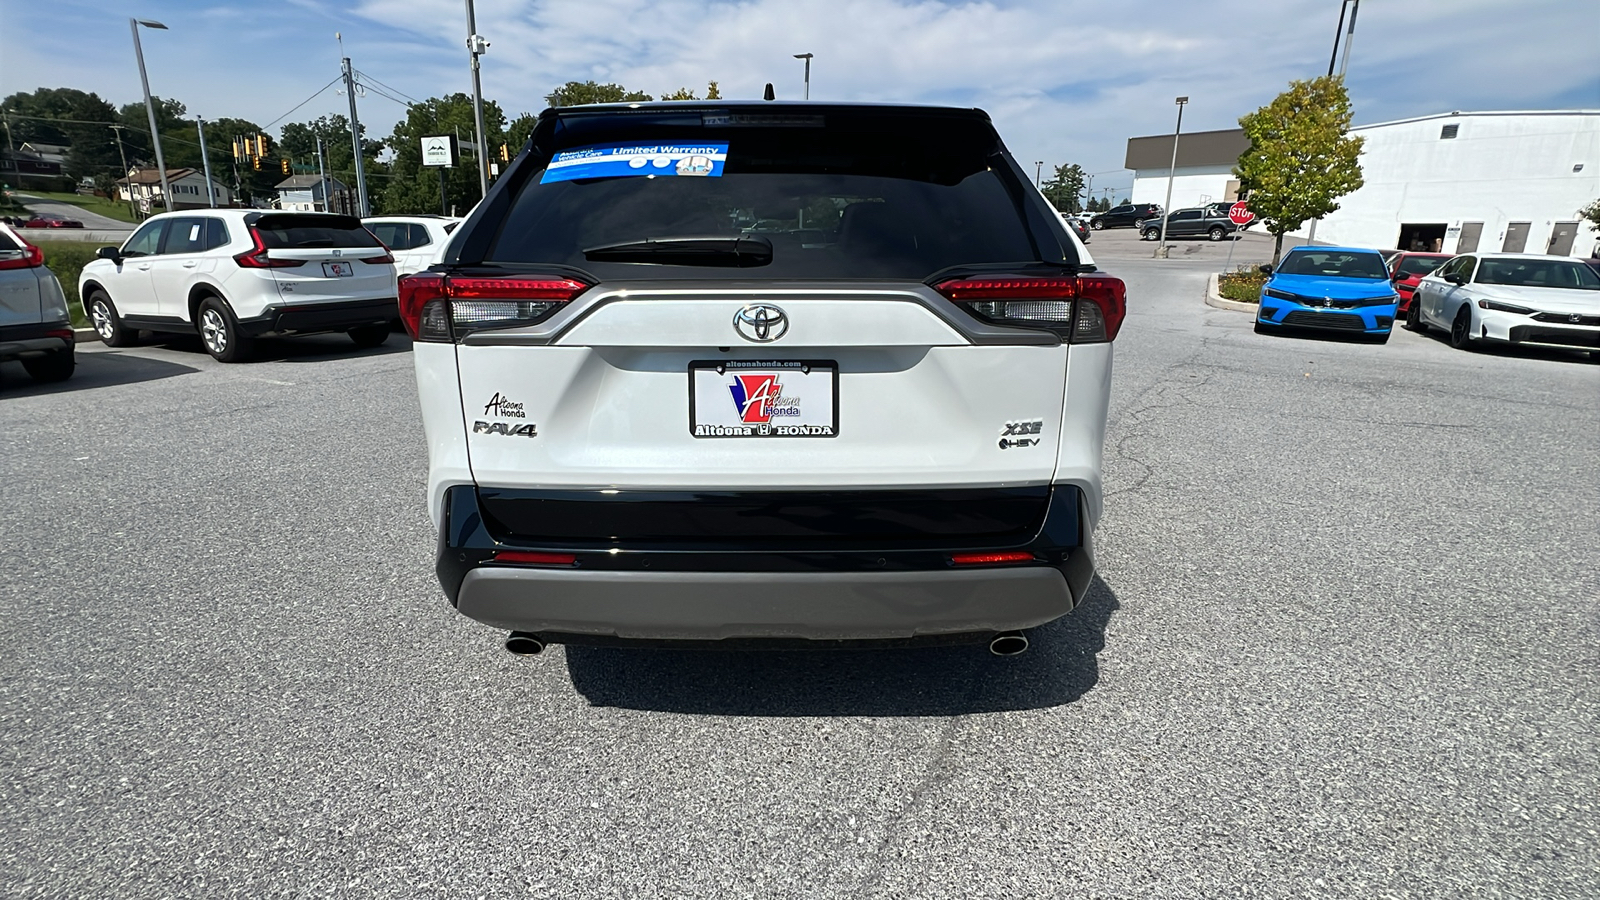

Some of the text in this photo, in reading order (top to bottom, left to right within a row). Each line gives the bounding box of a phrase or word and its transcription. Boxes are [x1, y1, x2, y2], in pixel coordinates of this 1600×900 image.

[612, 146, 719, 156] Limited Warranty
[725, 360, 802, 368] altoonahonda.com
[501, 409, 526, 418] Honda
[765, 406, 800, 416] Honda
[473, 420, 538, 438] RAV4
[695, 424, 752, 436] Altoona
[777, 426, 833, 435] HONDA
[1001, 420, 1043, 436] XSE
